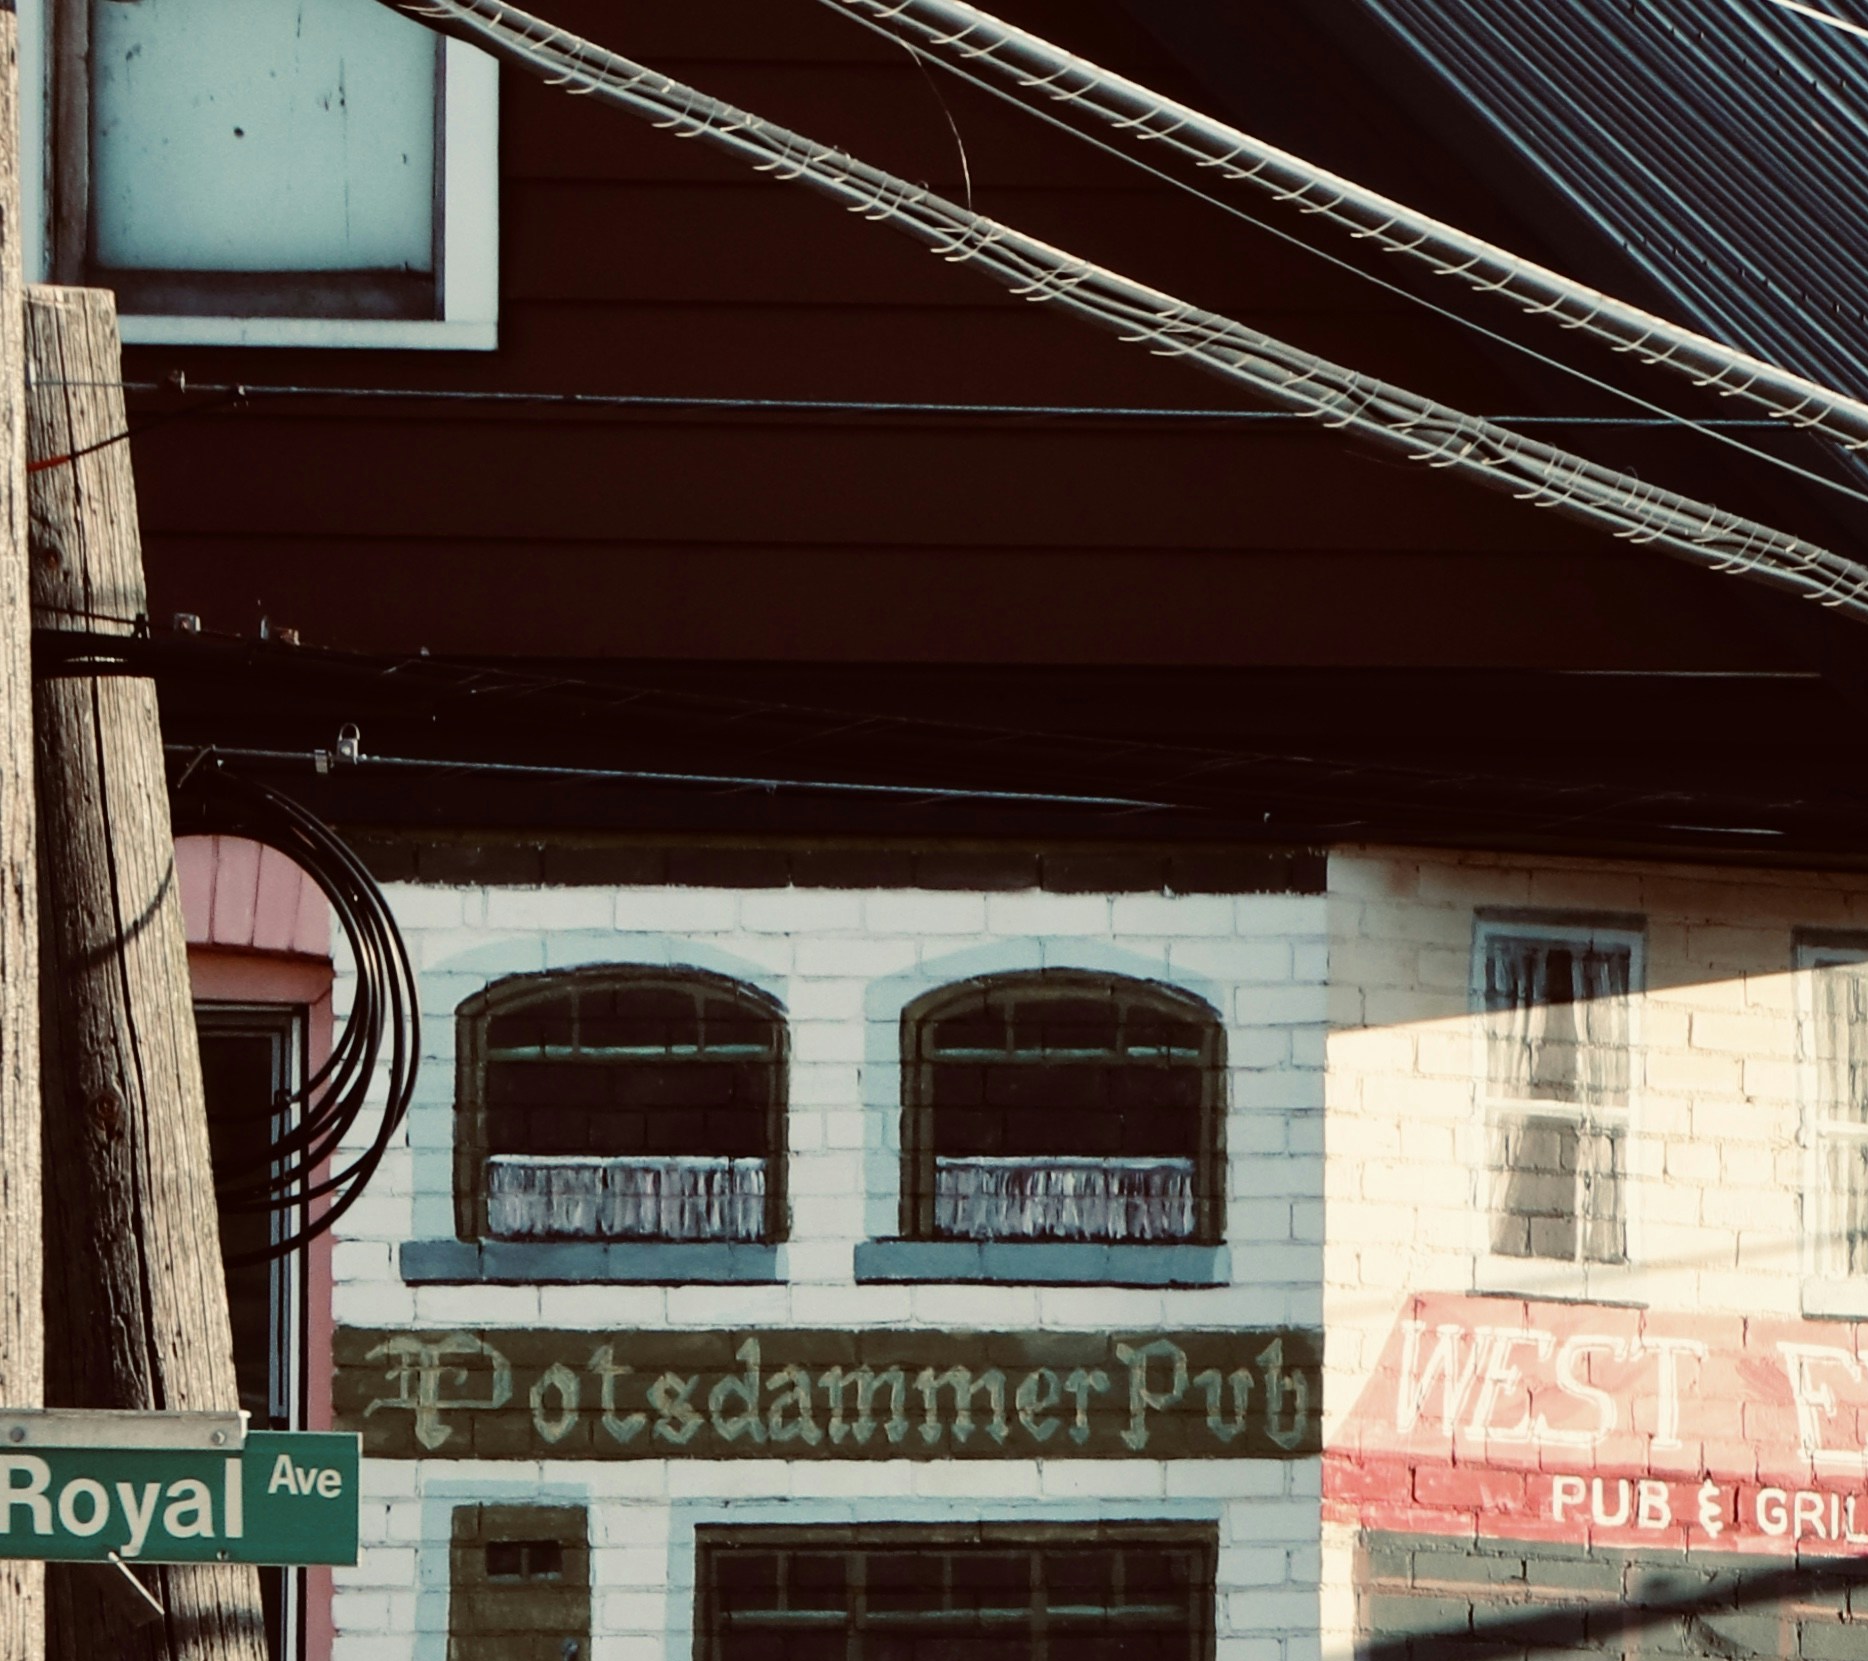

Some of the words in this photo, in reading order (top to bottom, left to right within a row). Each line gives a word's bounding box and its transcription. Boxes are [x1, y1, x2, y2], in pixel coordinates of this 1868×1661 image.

[1396, 1320, 1707, 1451] WEST
[0, 1454, 244, 1557] Royal
[268, 1454, 342, 1498] Ave
[1552, 1475, 1671, 1530] PUB
[1698, 1479, 1724, 1538] &
